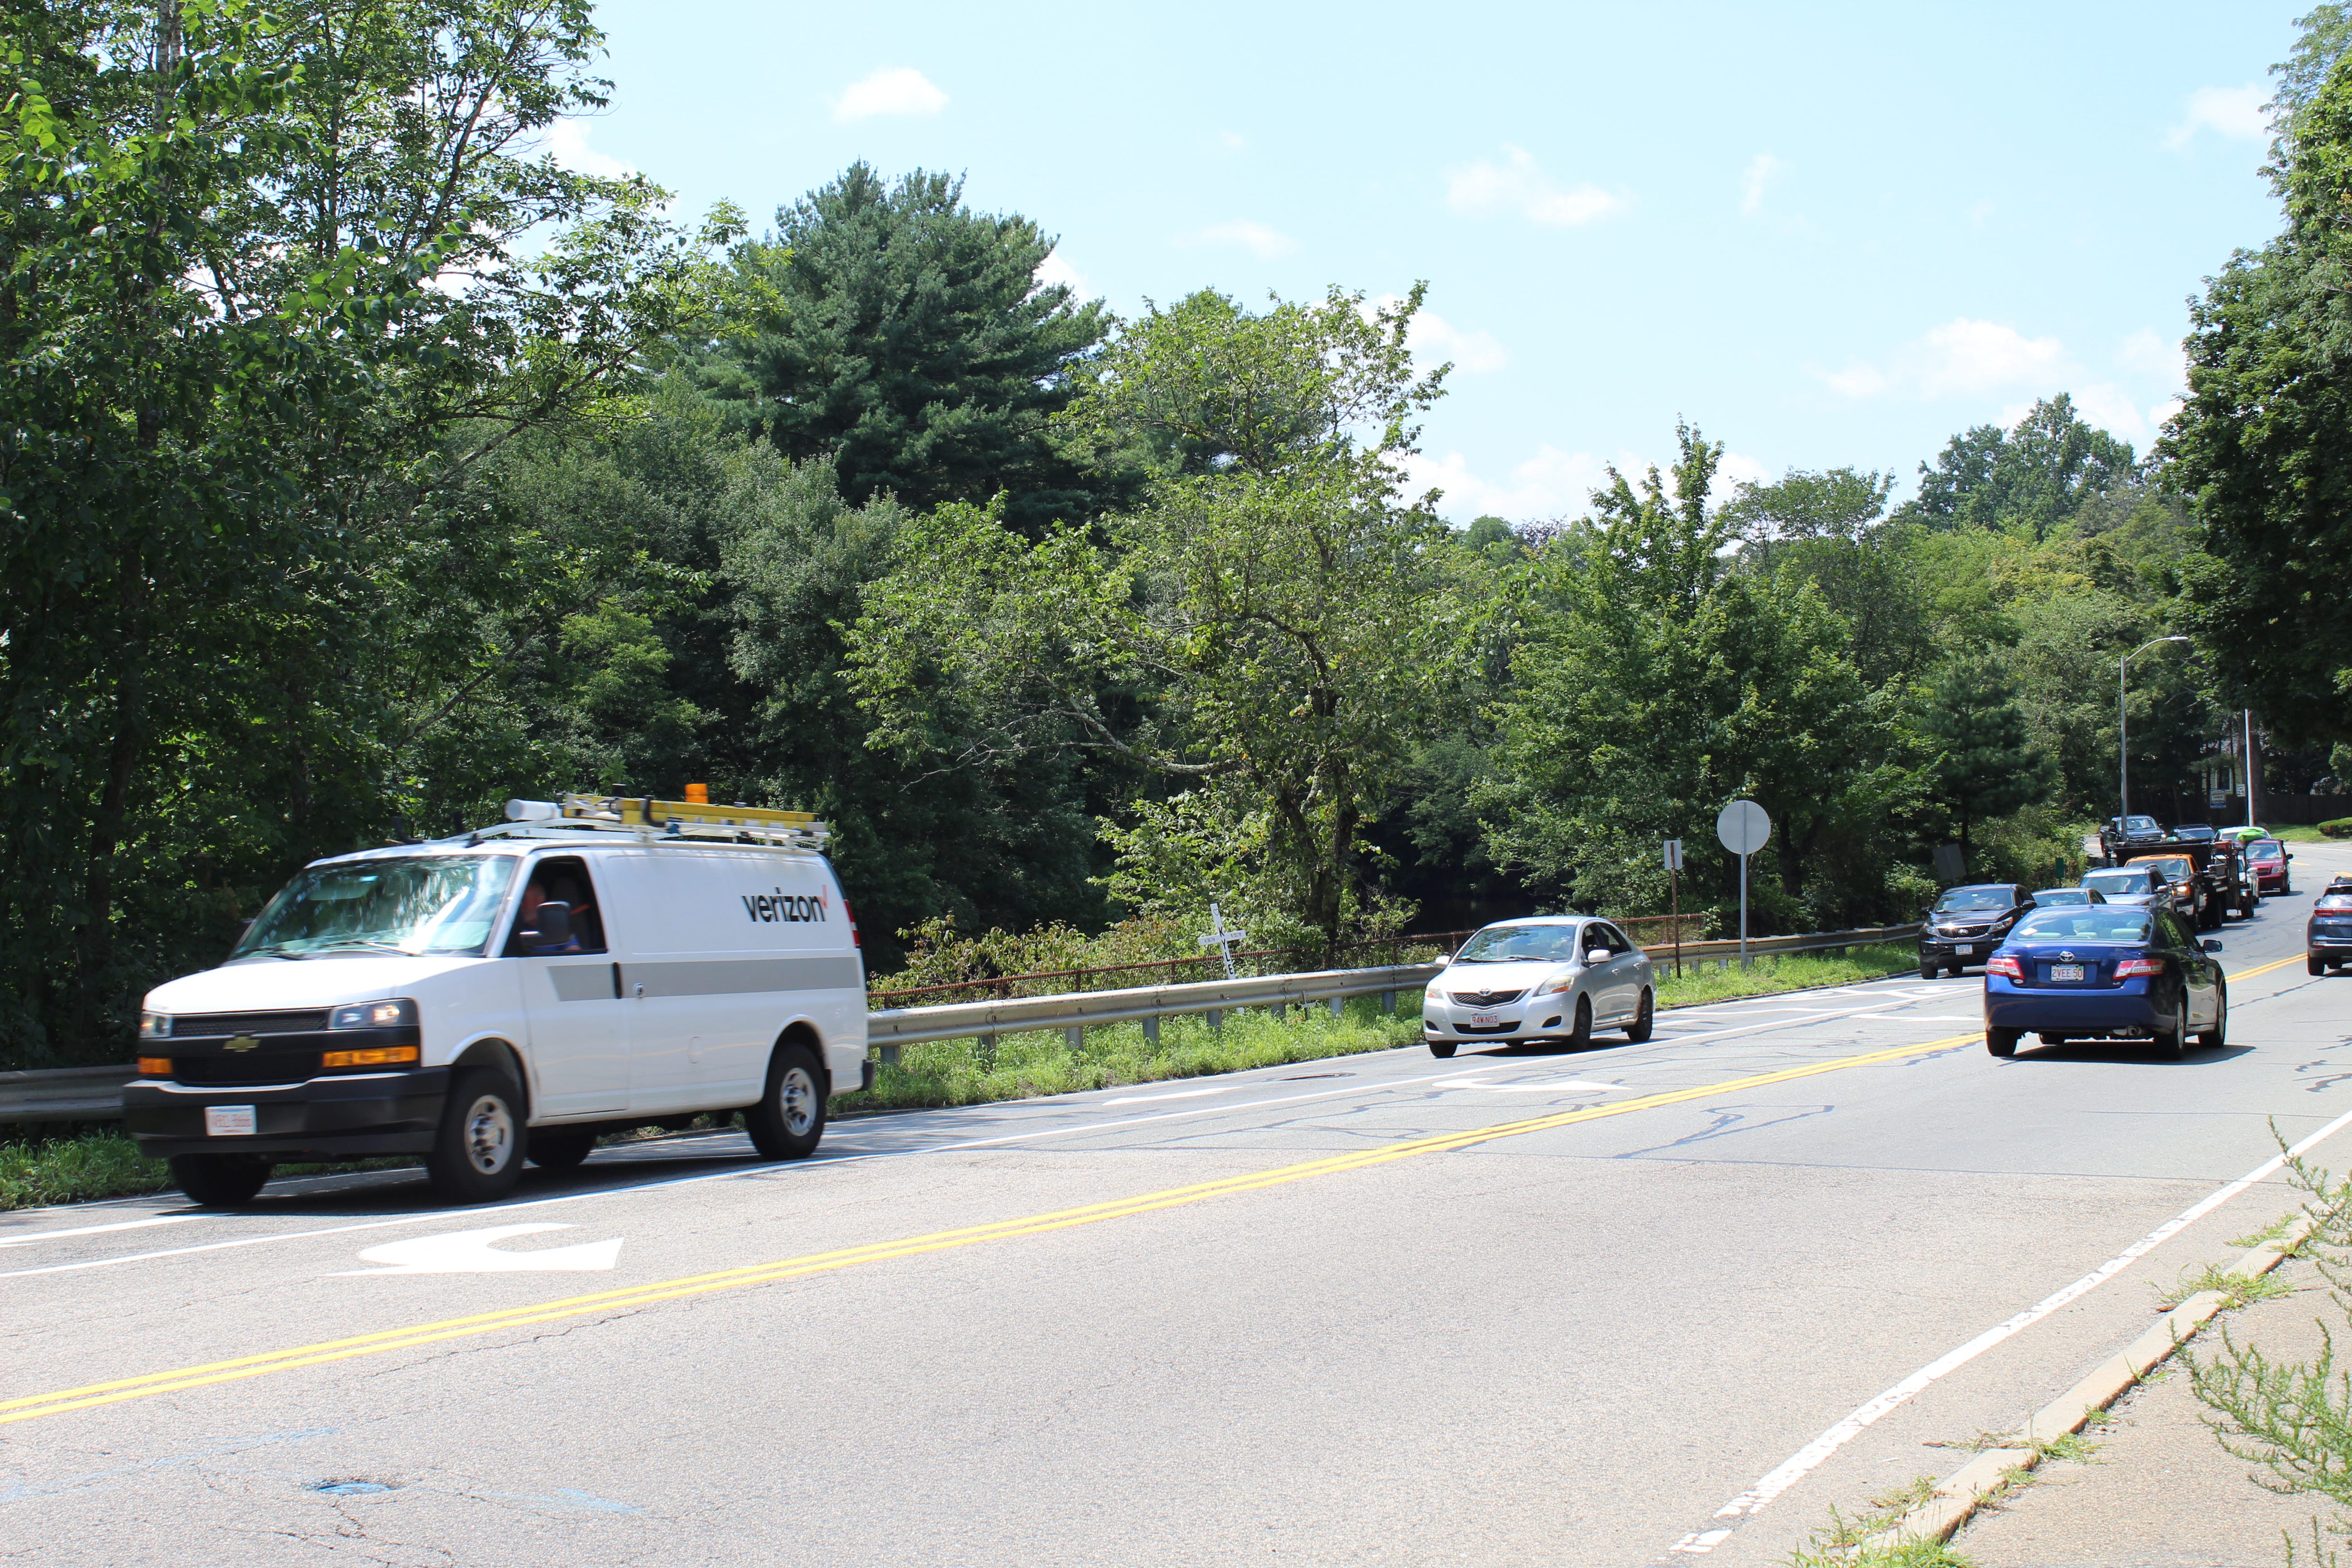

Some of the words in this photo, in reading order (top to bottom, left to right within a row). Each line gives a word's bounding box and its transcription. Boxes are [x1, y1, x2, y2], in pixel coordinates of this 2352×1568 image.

[741, 886, 826, 922] verizon
[1219, 926, 1233, 974] KYLE
[2052, 969, 2071, 977] 2VEE
[2073, 969, 2082, 977] 50
